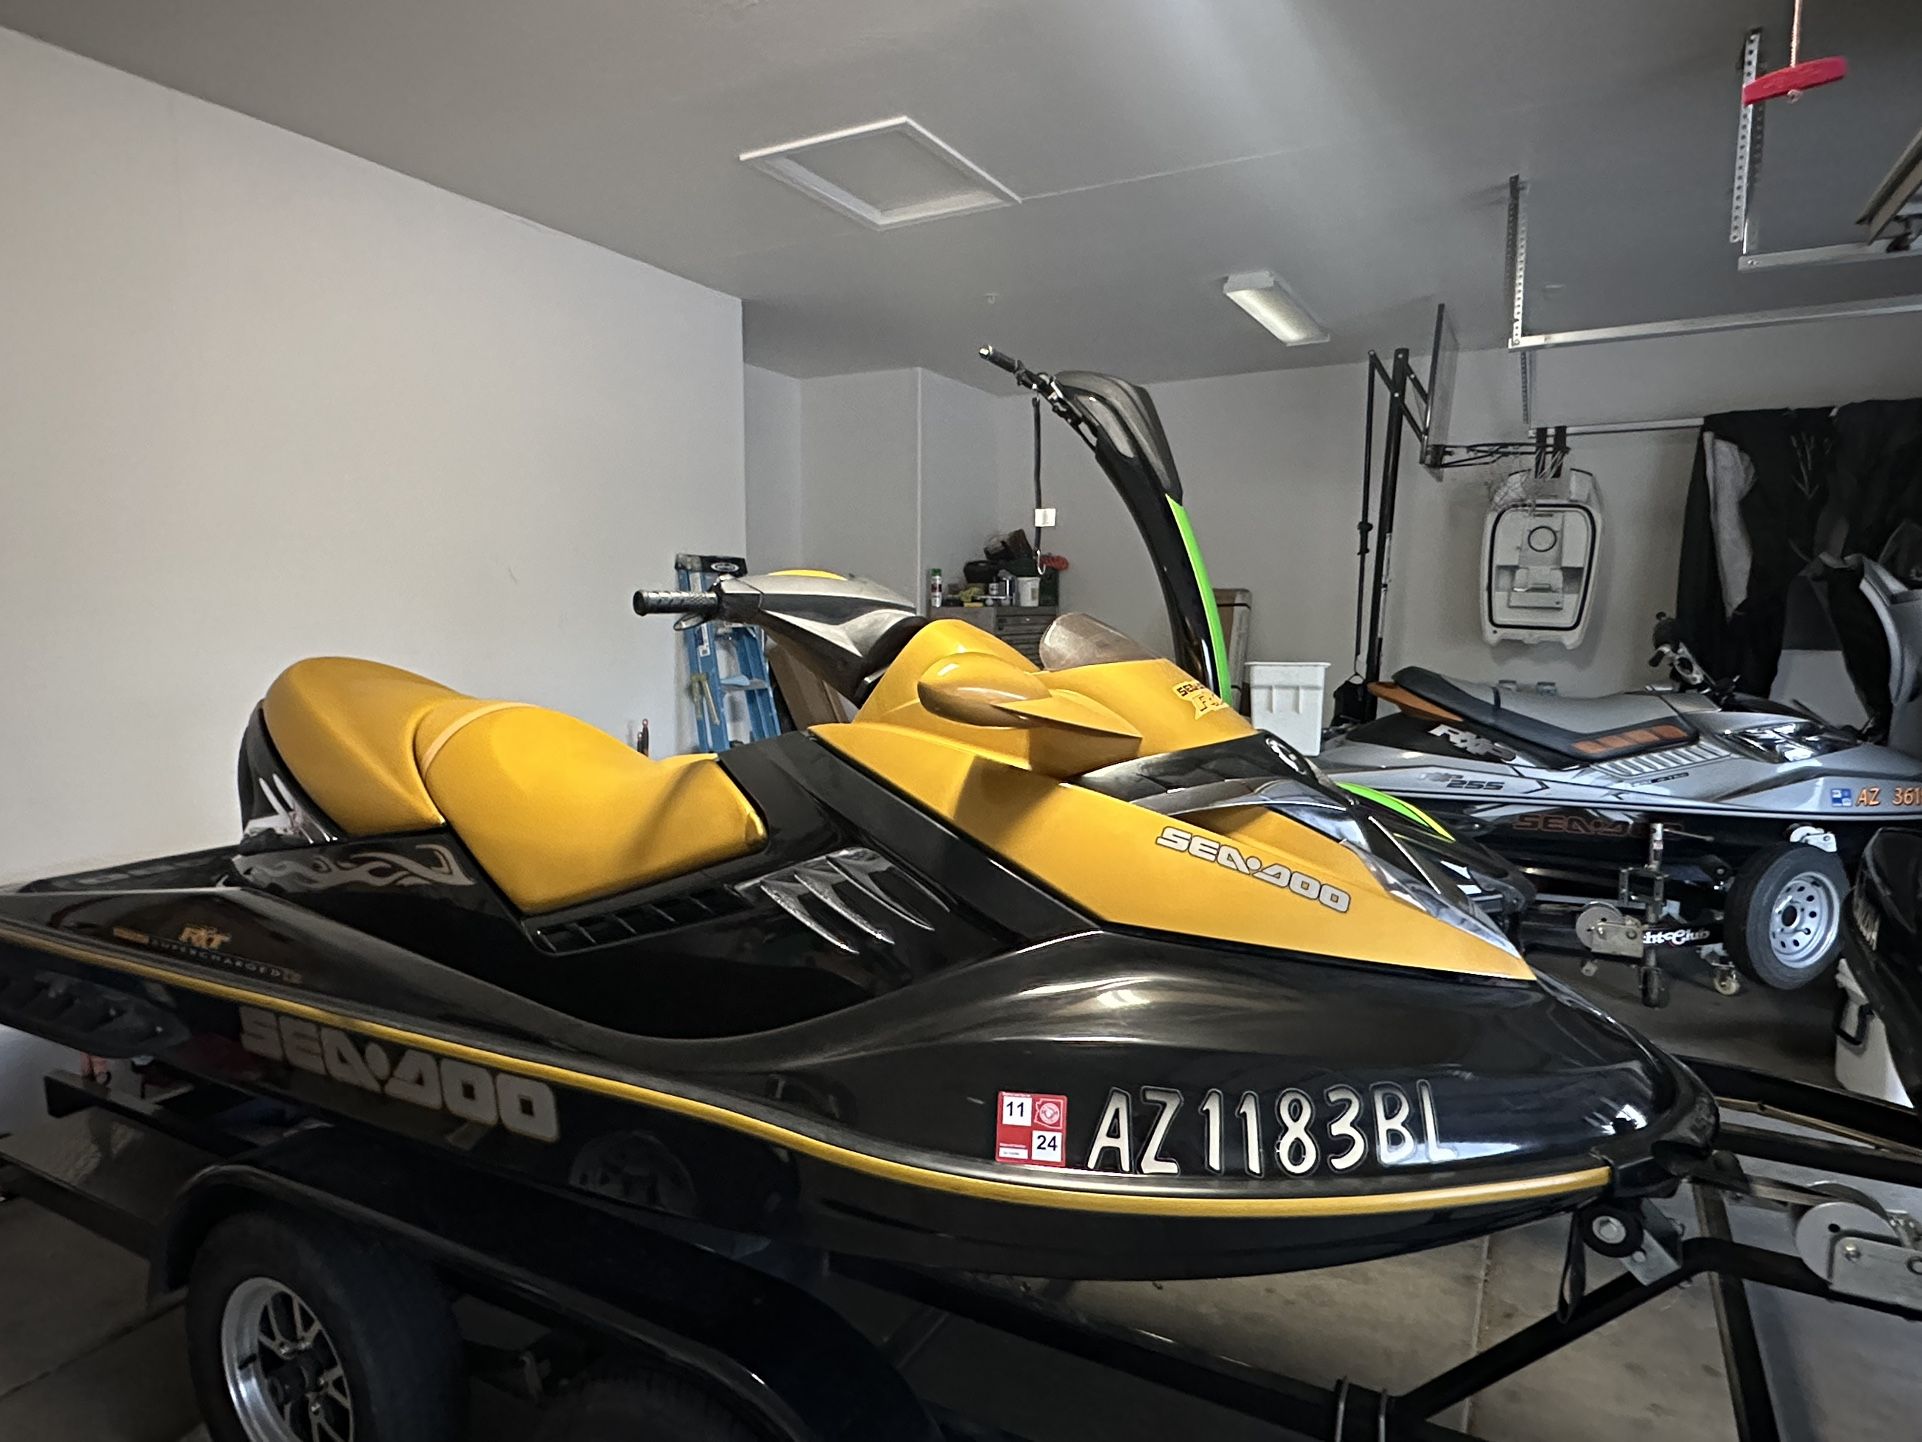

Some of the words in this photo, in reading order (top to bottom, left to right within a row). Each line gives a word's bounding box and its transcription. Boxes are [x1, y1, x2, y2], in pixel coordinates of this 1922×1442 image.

[1446, 780, 1505, 791] 255
[1856, 787, 1881, 806] AZ
[1892, 786, 1922, 806] 361
[1006, 1101, 1025, 1117] 11
[1085, 1086, 1184, 1176] AZ
[1036, 1134, 1058, 1152] 24
